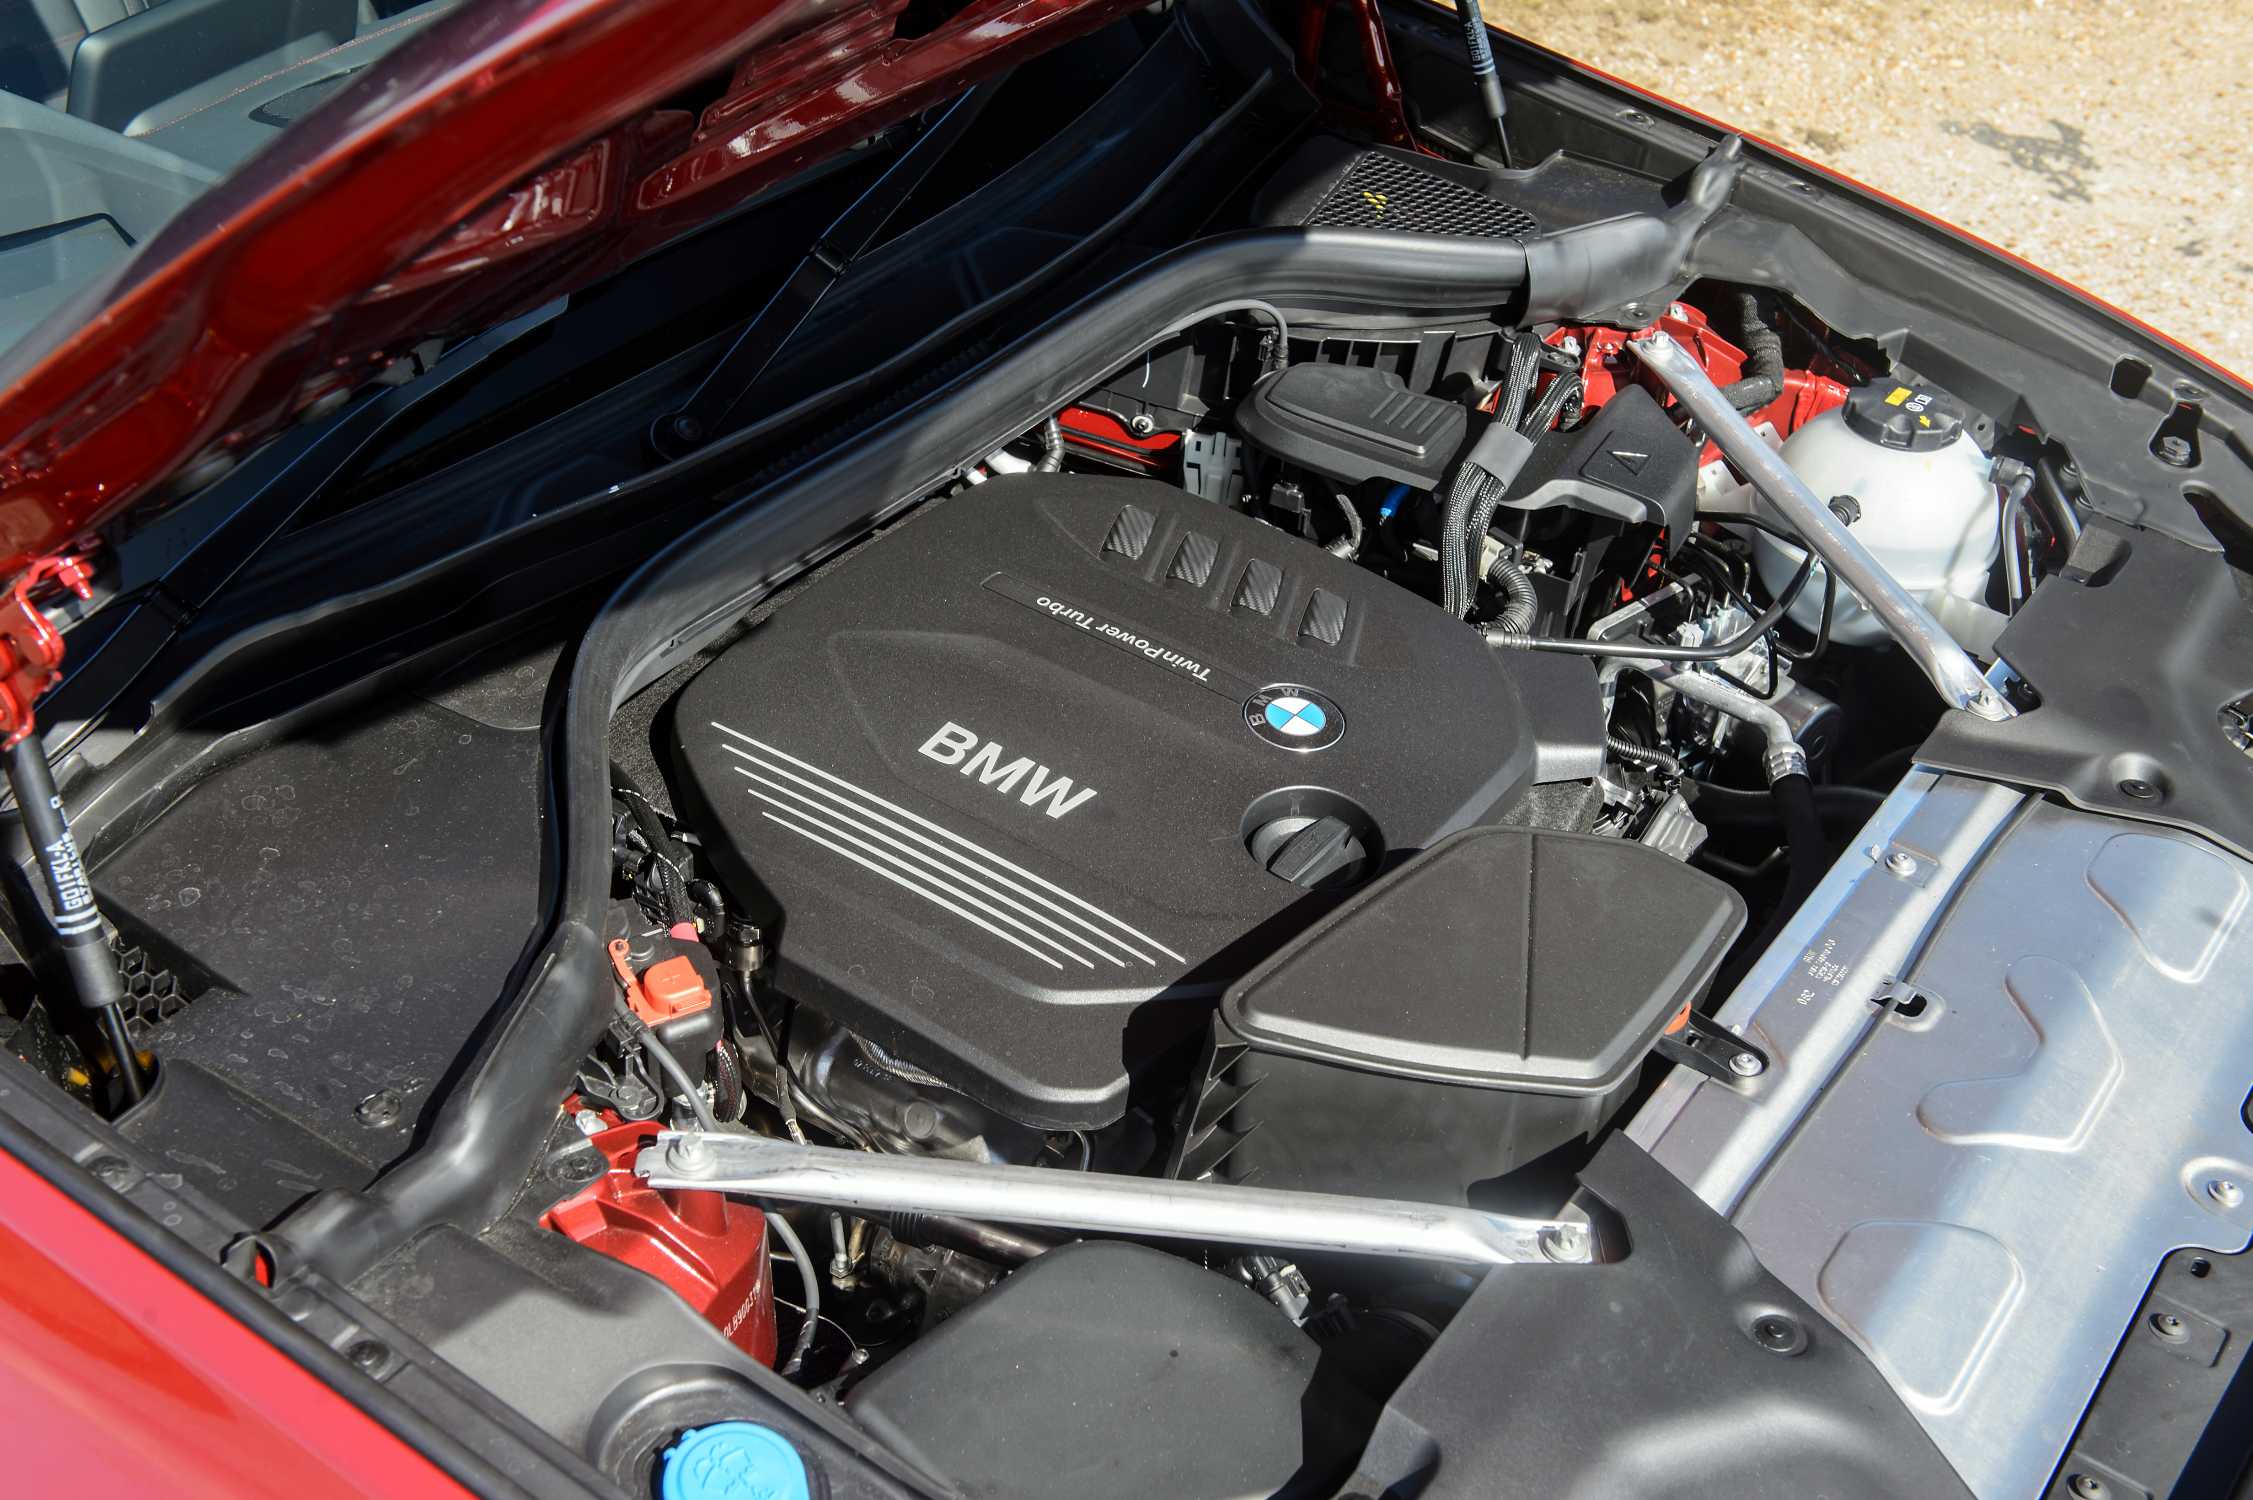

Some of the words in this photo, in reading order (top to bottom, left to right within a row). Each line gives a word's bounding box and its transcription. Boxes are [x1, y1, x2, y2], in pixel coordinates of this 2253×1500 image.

[1036, 596, 1095, 630] Turbo
[1096, 622, 1211, 682] TwinPower
[1249, 687, 1300, 727] BMW
[917, 721, 1098, 820] BMW
